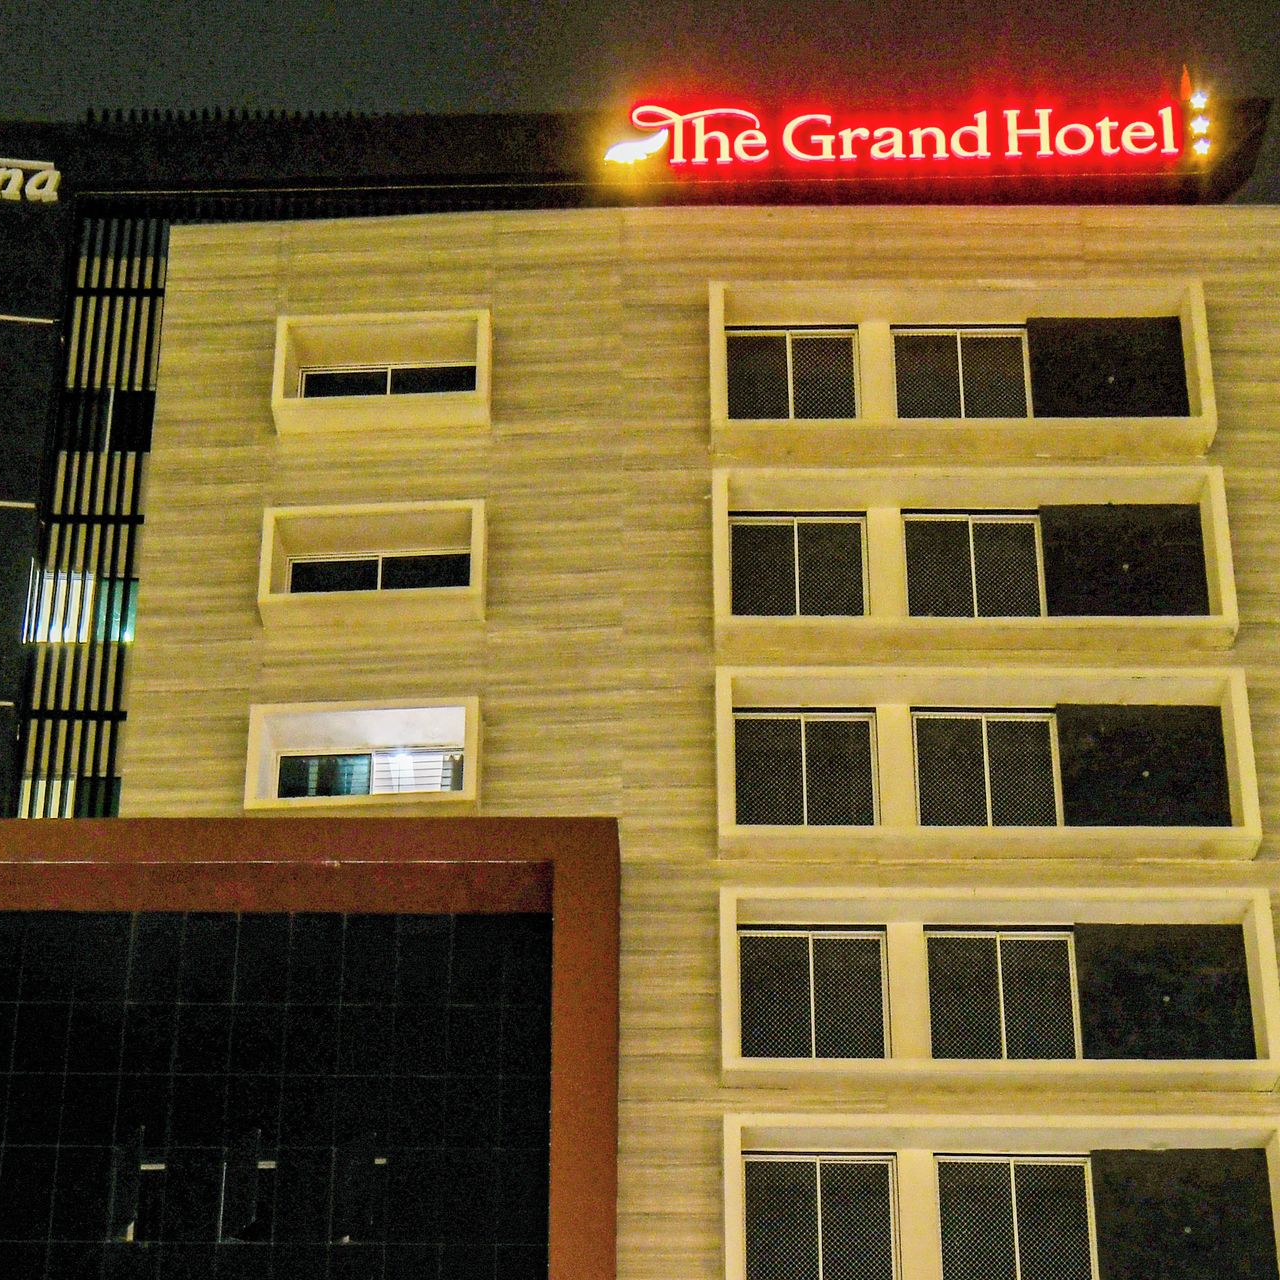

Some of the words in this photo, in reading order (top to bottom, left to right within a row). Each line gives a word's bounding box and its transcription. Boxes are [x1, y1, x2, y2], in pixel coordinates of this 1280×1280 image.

[631, 105, 769, 164] The
[782, 110, 991, 162] Grand
[1004, 106, 1183, 158] Hotel
